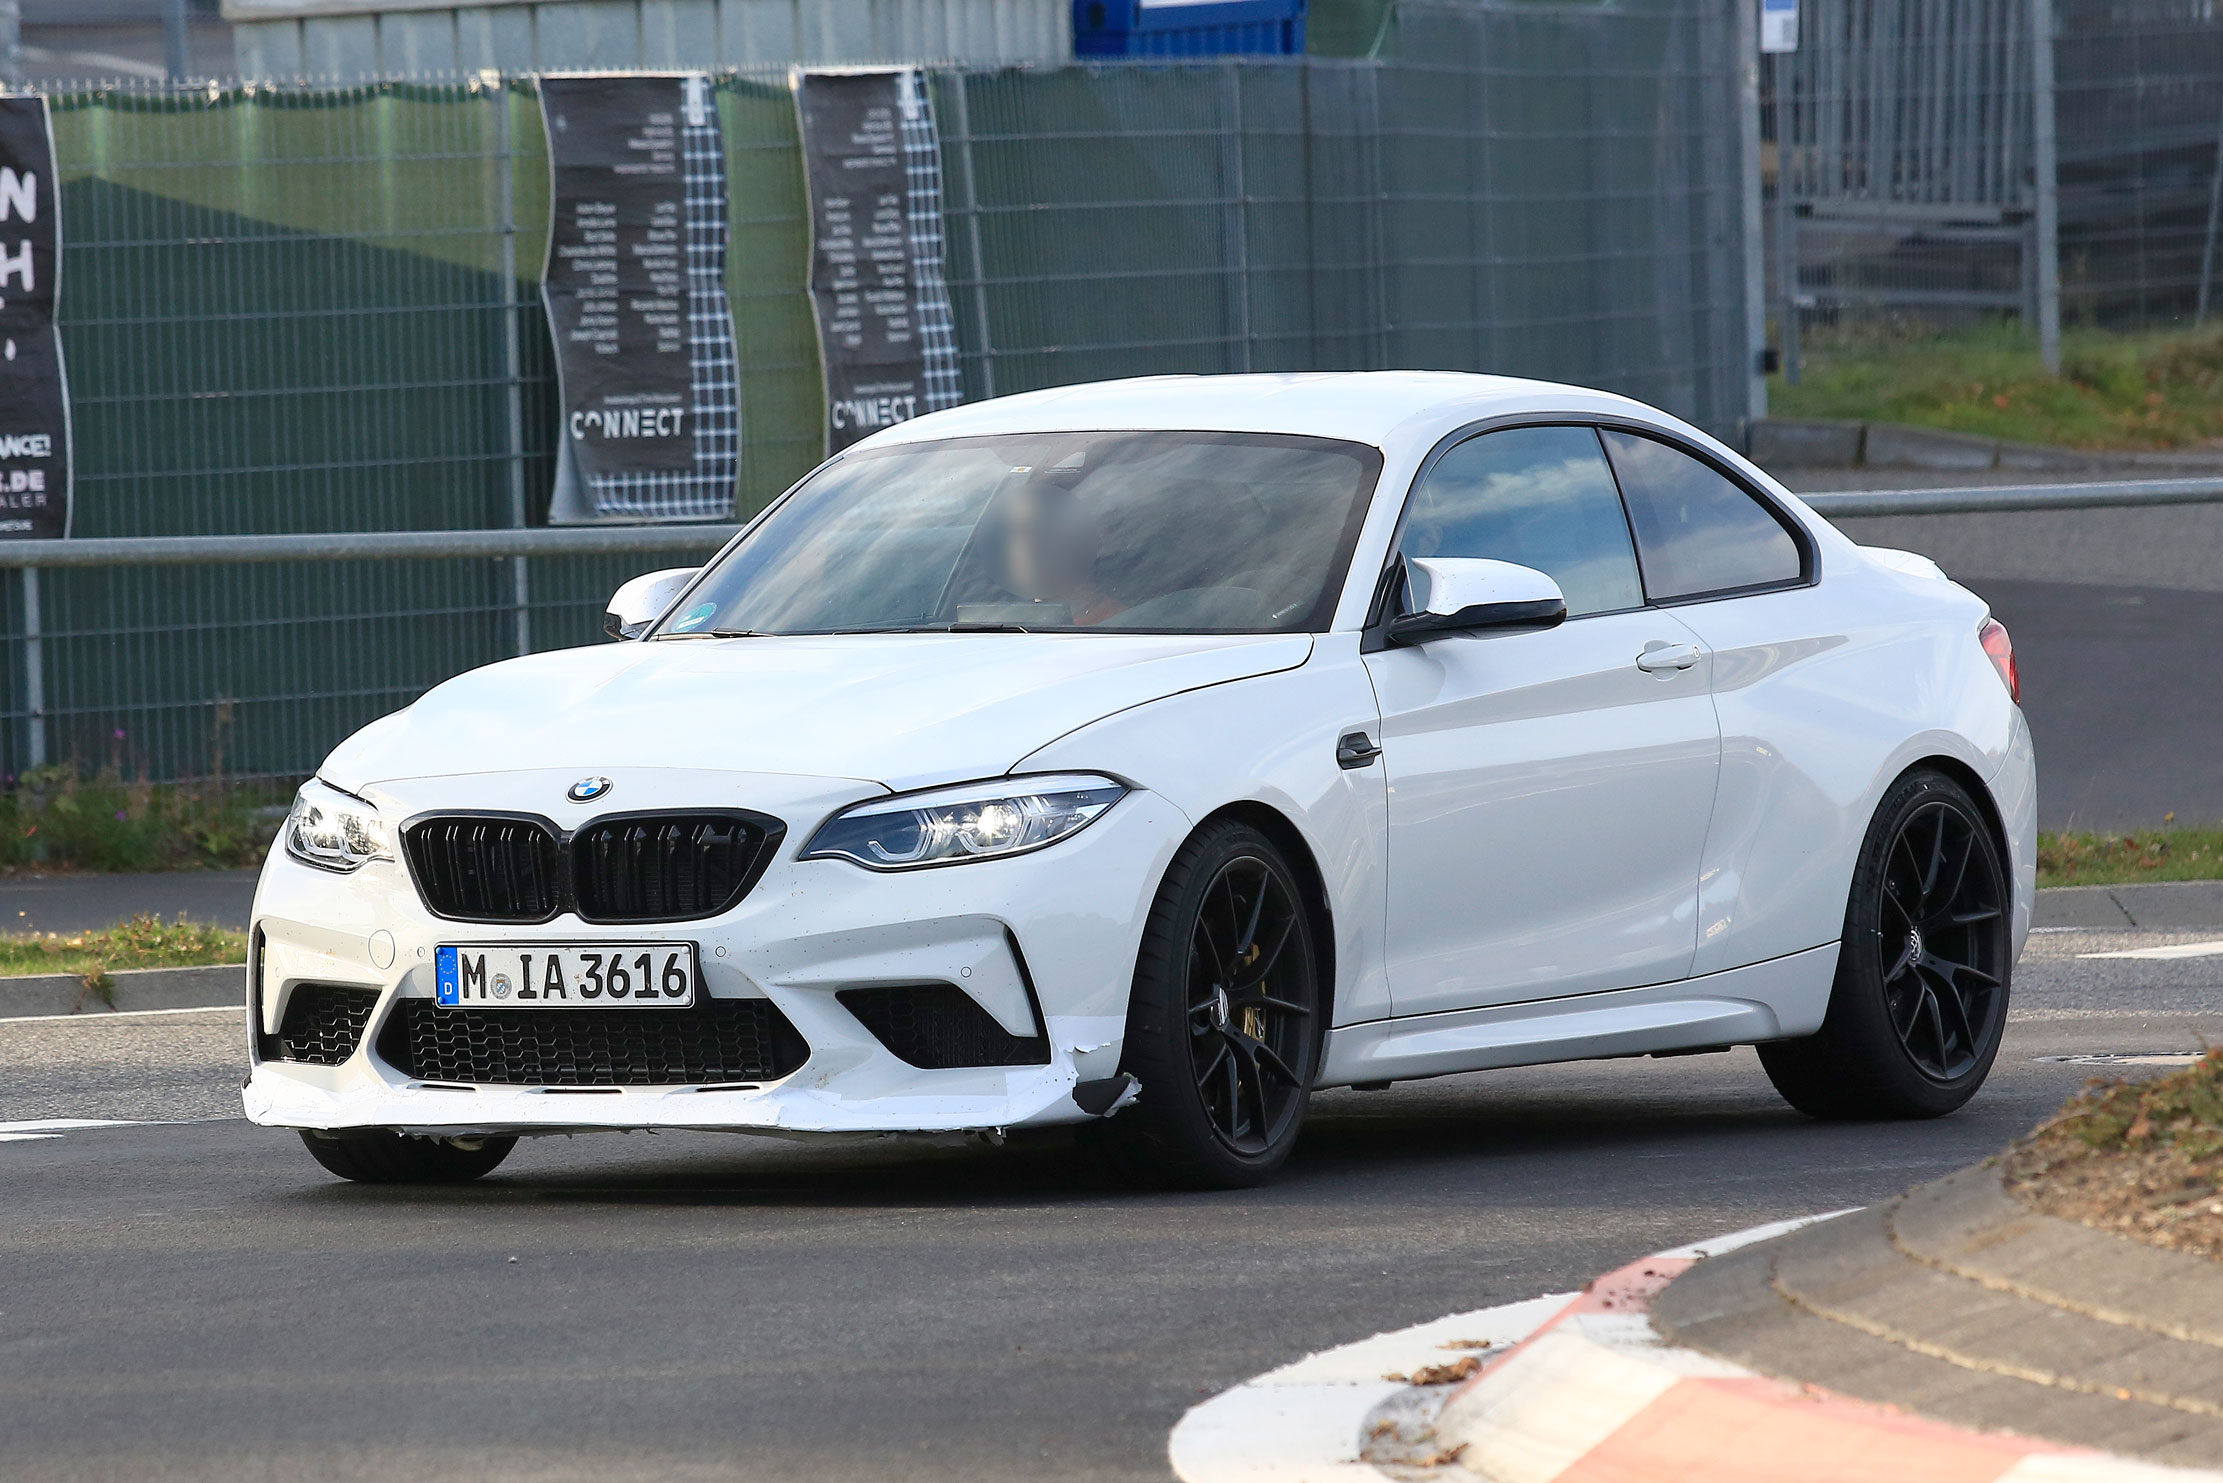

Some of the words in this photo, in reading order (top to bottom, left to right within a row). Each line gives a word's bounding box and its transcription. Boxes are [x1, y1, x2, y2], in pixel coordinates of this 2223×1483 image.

[444, 982, 453, 995] D
[461, 953, 486, 999] M
[579, 952, 687, 999] 3616
